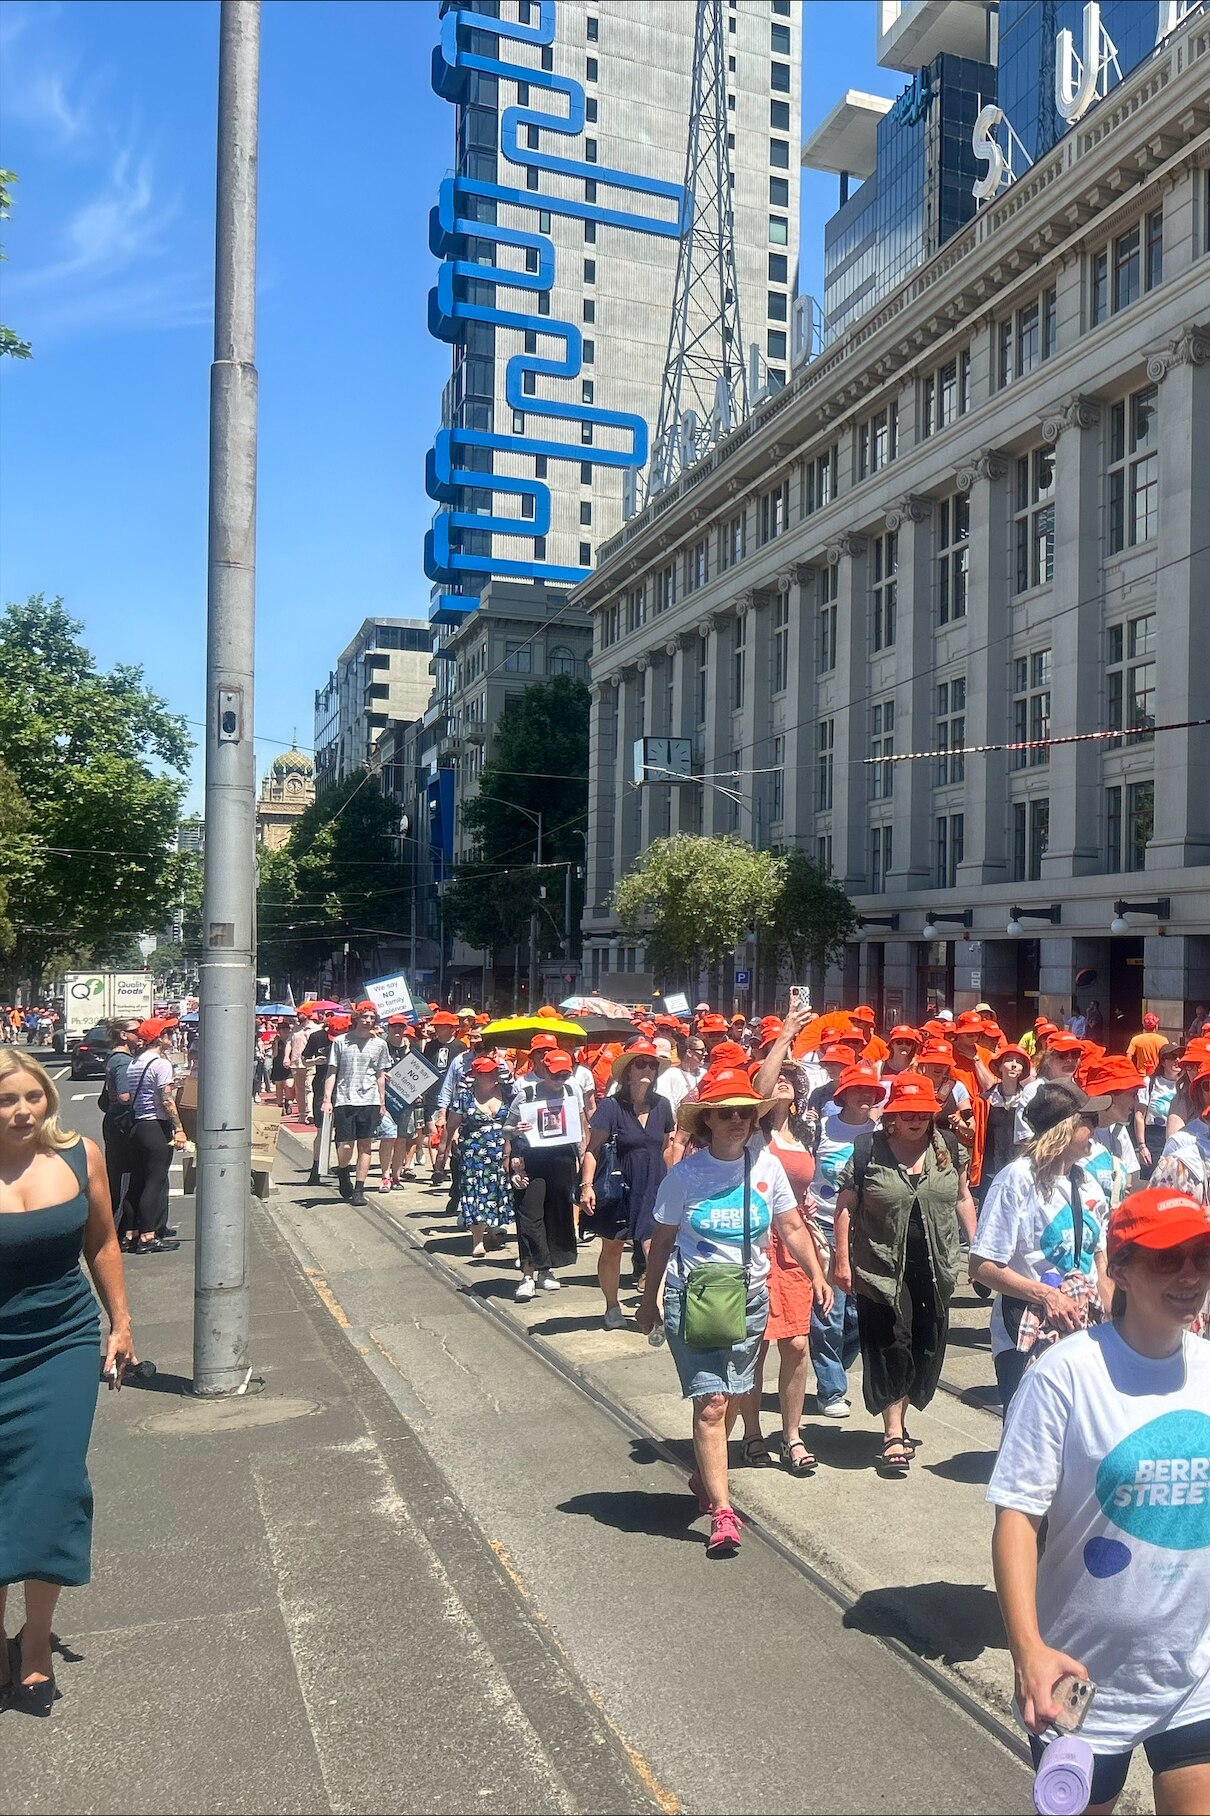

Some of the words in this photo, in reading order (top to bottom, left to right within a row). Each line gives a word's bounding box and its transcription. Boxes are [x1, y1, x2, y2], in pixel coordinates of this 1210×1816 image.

[737, 972, 746, 983] P
[117, 981, 147, 990] Quality
[382, 990, 395, 998] NO
[385, 996, 405, 1006] family
[407, 1069, 420, 1081] NO
[410, 1059, 420, 1070] We
[420, 1068, 431, 1080] say
[394, 1070, 402, 1078] to
[401, 1076, 418, 1093] family
[710, 1204, 759, 1220] BERY
[699, 1216, 762, 1230] STRET
